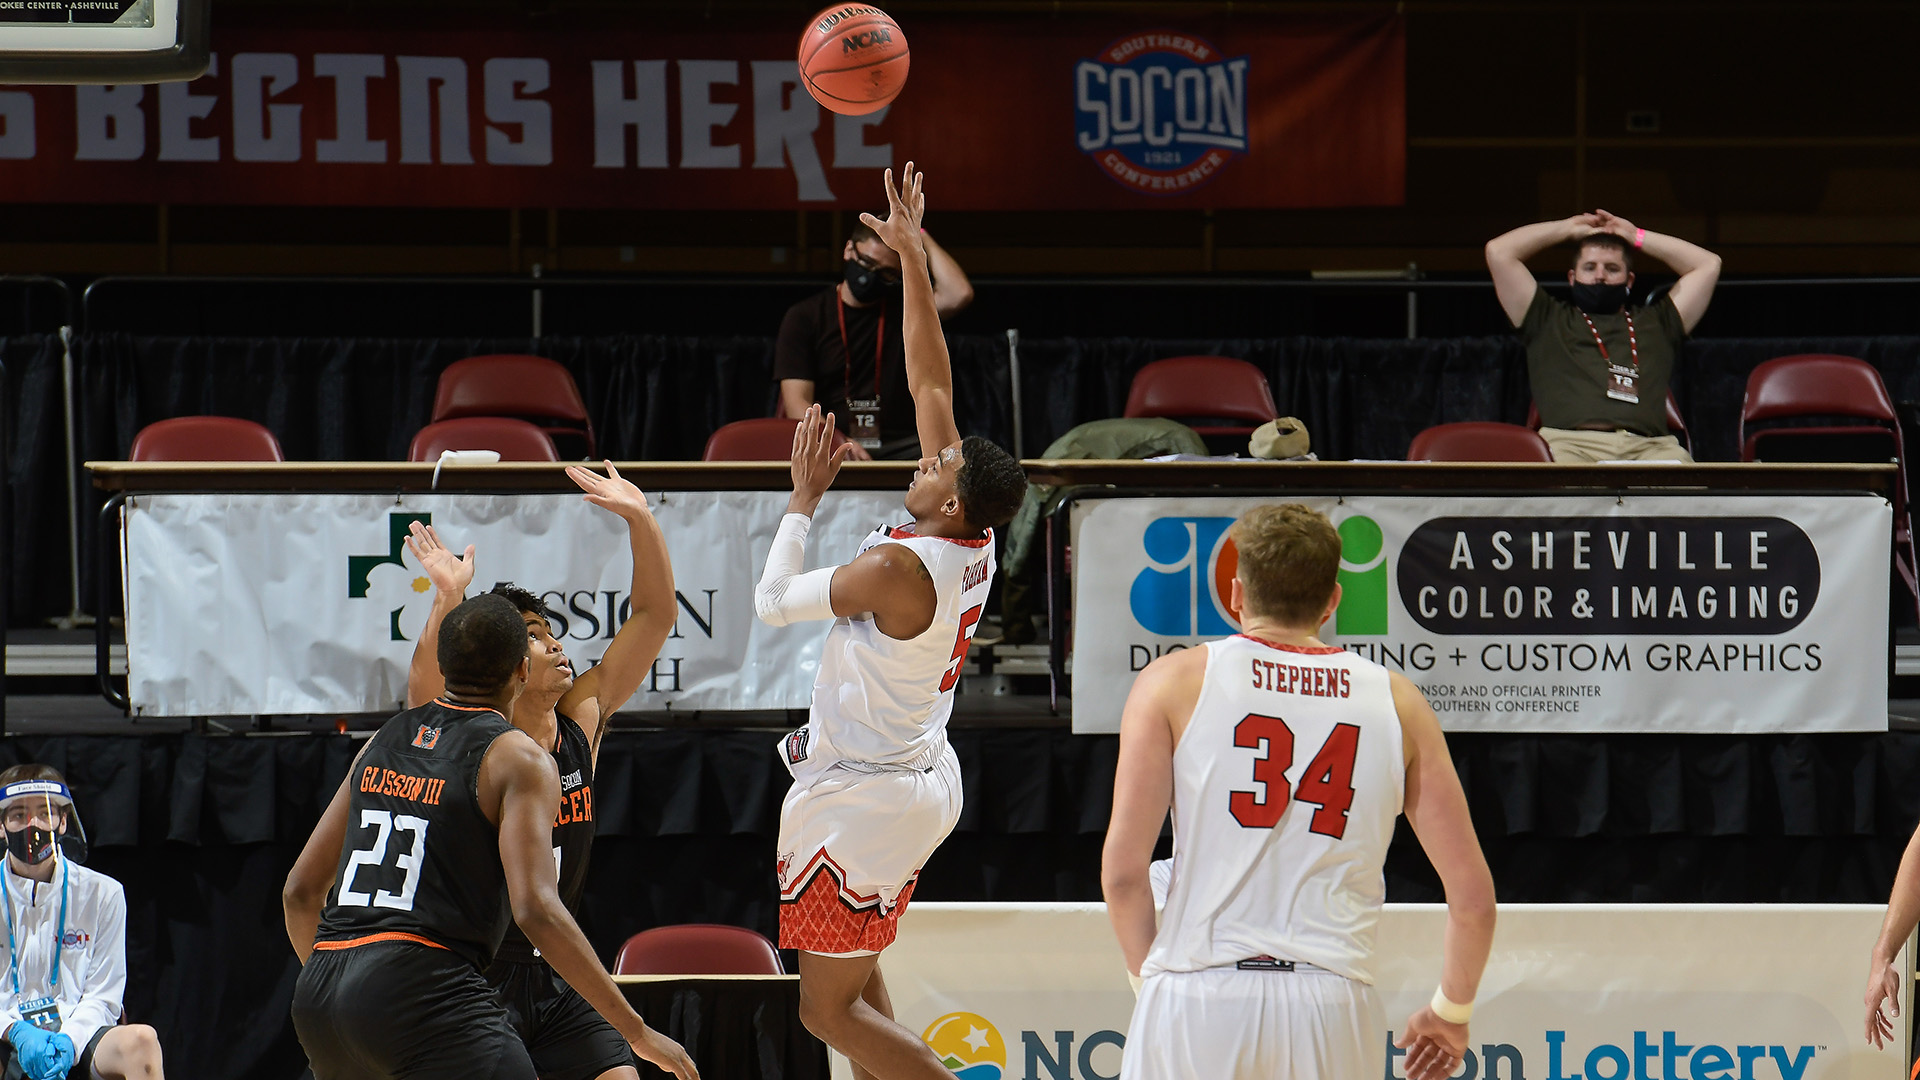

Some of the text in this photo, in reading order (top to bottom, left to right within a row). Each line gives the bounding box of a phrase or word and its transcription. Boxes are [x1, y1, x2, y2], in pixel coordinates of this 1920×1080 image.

[842, 28, 892, 54] NCAA
[1110, 34, 1210, 62] SOUTHERN
[75, 53, 553, 166] BEGINS
[1076, 59, 1248, 150] SOCON
[1103, 152, 1223, 189] CONFERENCE
[1144, 152, 1182, 165] 1921
[855, 414, 875, 427] T2
[1449, 530, 1768, 570] ASHEVILLE
[1418, 585, 1799, 619] COLOR & IMAGING
[938, 603, 983, 694] 5
[1480, 643, 1632, 671] CUSTOM
[1646, 643, 1823, 671] GRAPHICS
[1251, 658, 1351, 698] STEPHENS
[1460, 684, 1488, 697] AND
[1492, 684, 1547, 697] OFFICIAL
[1551, 684, 1602, 697] PRINTER
[1495, 700, 1580, 712] CONFERENCE
[360, 766, 446, 805] GLISSON III
[1228, 713, 1361, 840] 34
[554, 786, 592, 827] CER
[338, 809, 430, 911] 23
[31, 1011, 53, 1026] T1
[1545, 1031, 1815, 1080] Lottery
